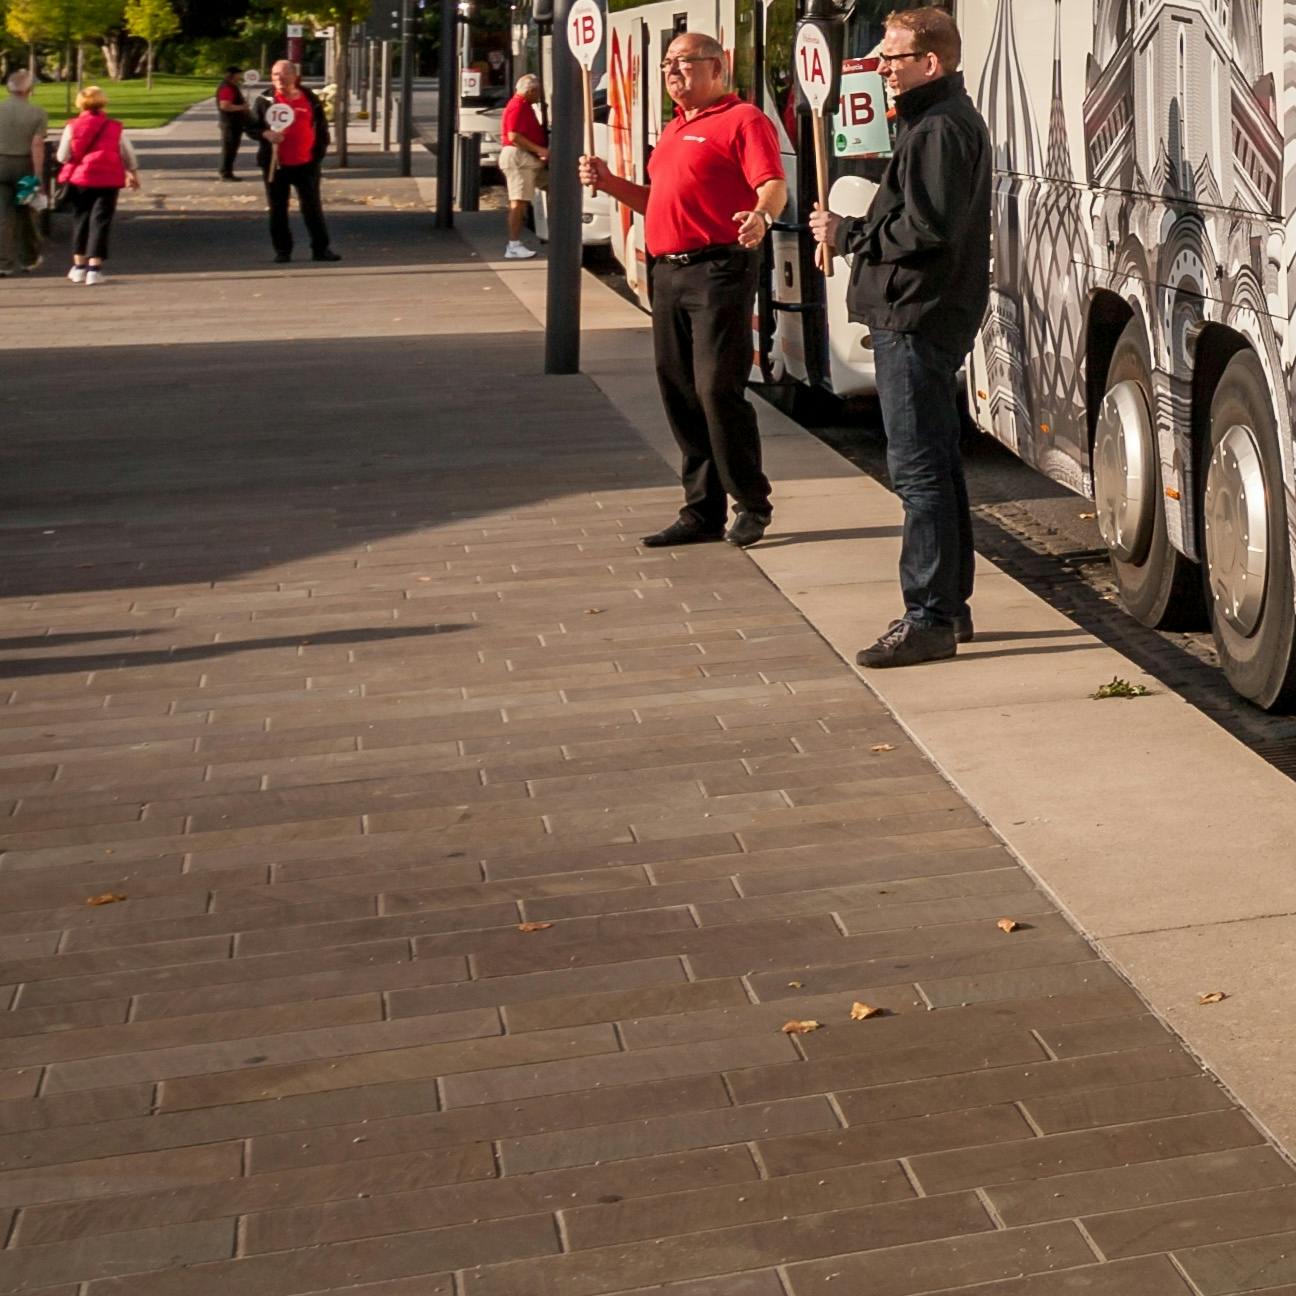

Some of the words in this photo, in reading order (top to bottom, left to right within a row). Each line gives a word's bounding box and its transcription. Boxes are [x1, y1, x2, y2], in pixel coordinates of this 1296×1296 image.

[572, 14, 596, 47] 1B
[800, 45, 826, 85] 1A
[271, 109, 289, 123] 1C
[838, 91, 875, 128] 1B
